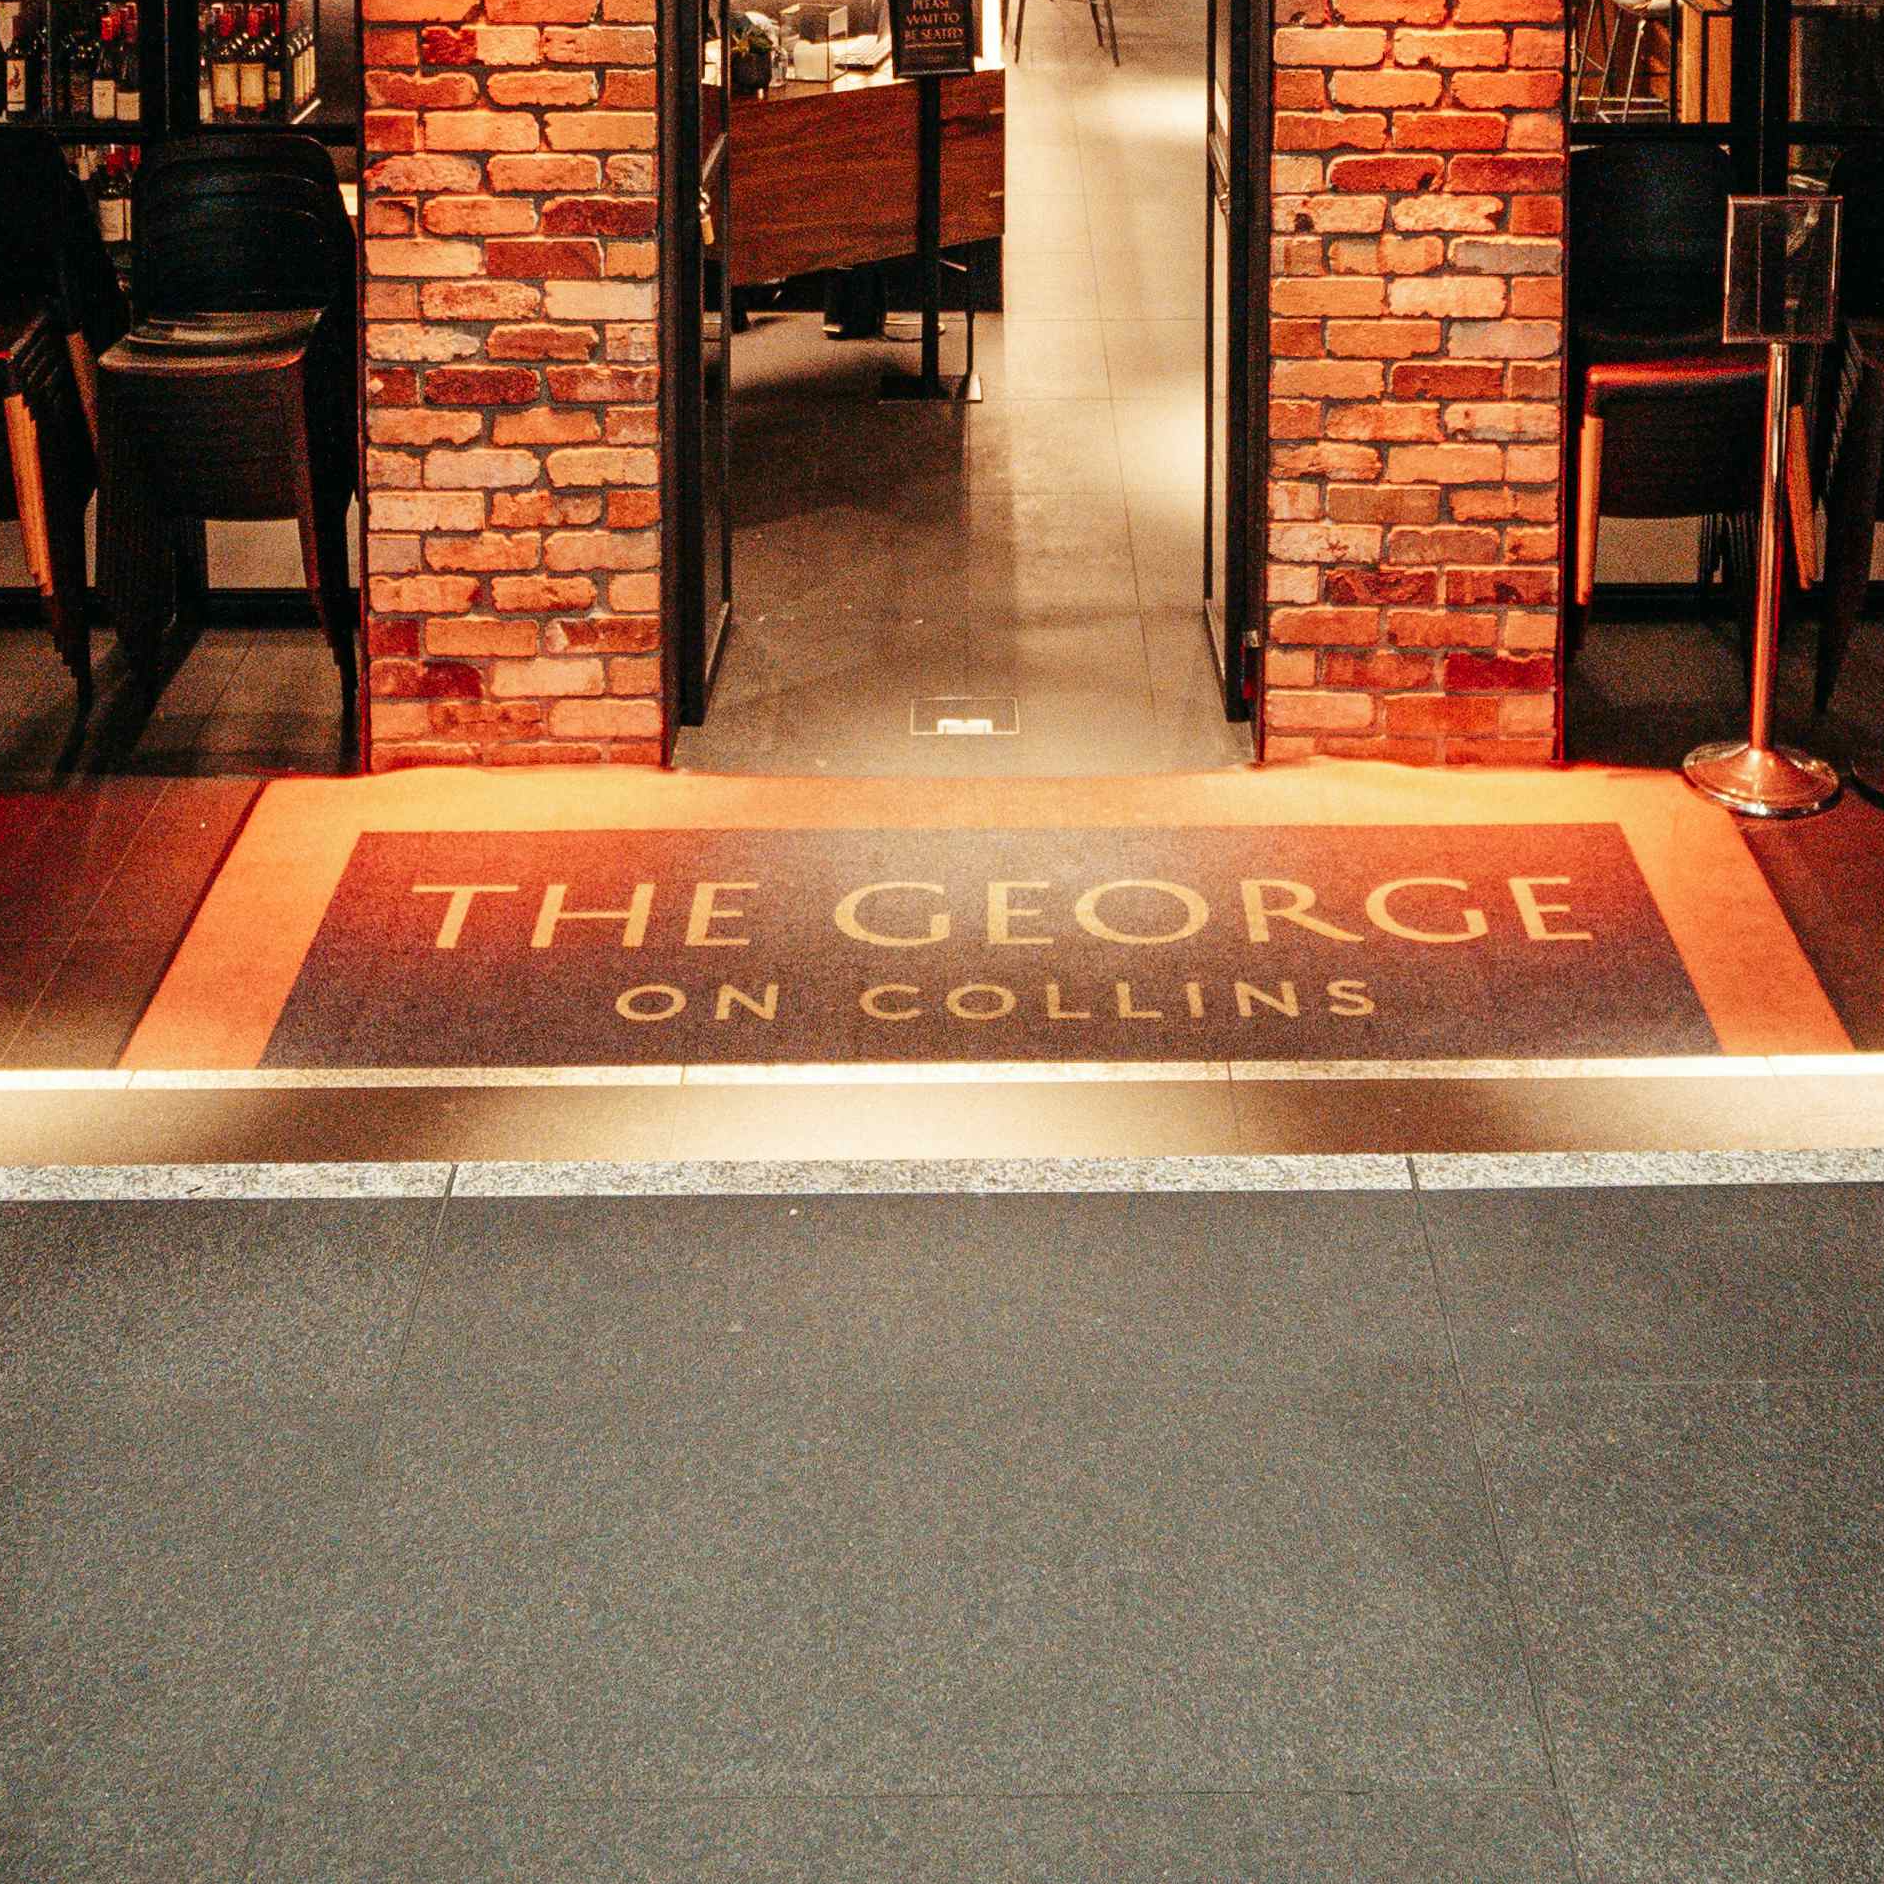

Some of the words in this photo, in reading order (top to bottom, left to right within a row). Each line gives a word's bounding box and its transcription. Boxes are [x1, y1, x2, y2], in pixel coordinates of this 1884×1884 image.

[905, 12, 938, 25] WAIT
[939, 12, 961, 24] TO
[412, 881, 759, 949] THE
[834, 876, 1593, 946] GEORGE
[615, 984, 780, 1022] ON
[859, 979, 1376, 1021] COLLINS
